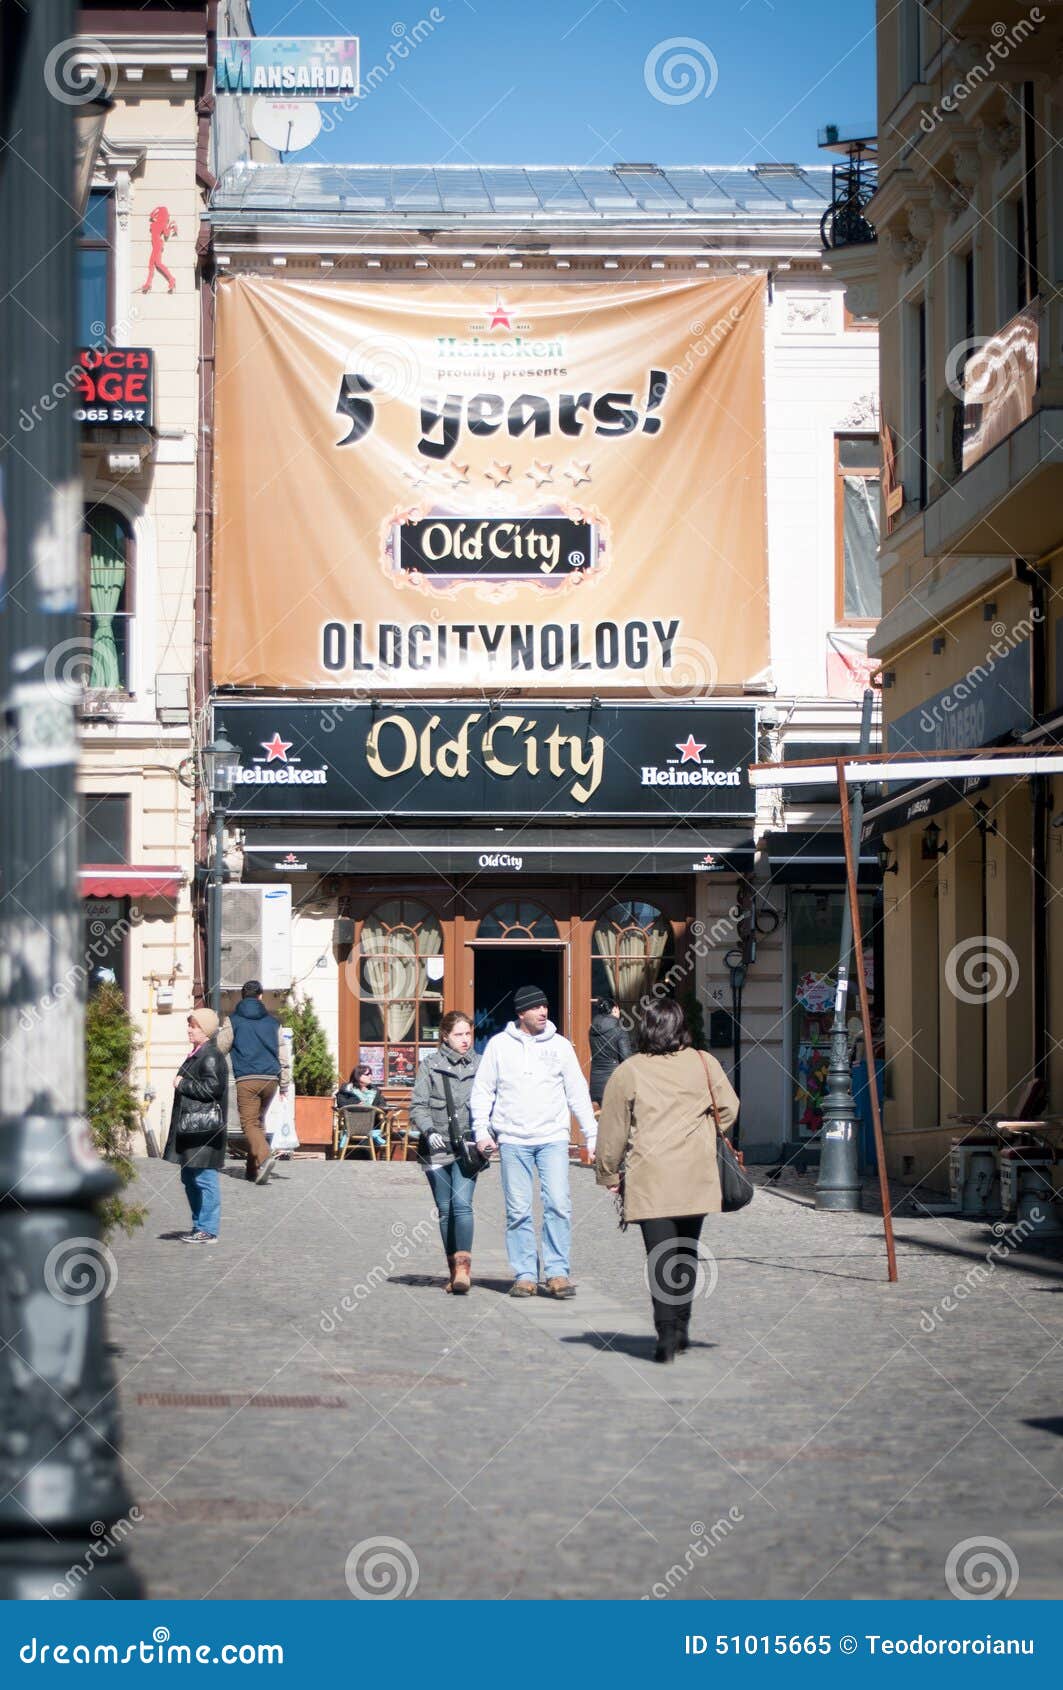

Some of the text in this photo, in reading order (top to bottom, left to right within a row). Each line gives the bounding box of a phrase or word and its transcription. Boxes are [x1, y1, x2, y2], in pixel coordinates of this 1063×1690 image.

[216, 55, 354, 91] MANSARDA
[437, 367, 568, 380] proudly presents
[112, 409, 146, 421] 547
[335, 370, 669, 461] 5 years!
[322, 619, 682, 671] OLDCITYNOLOGY
[365, 713, 605, 804] Old City
[227, 765, 328, 785] Heineken
[641, 767, 741, 786] Heineken
